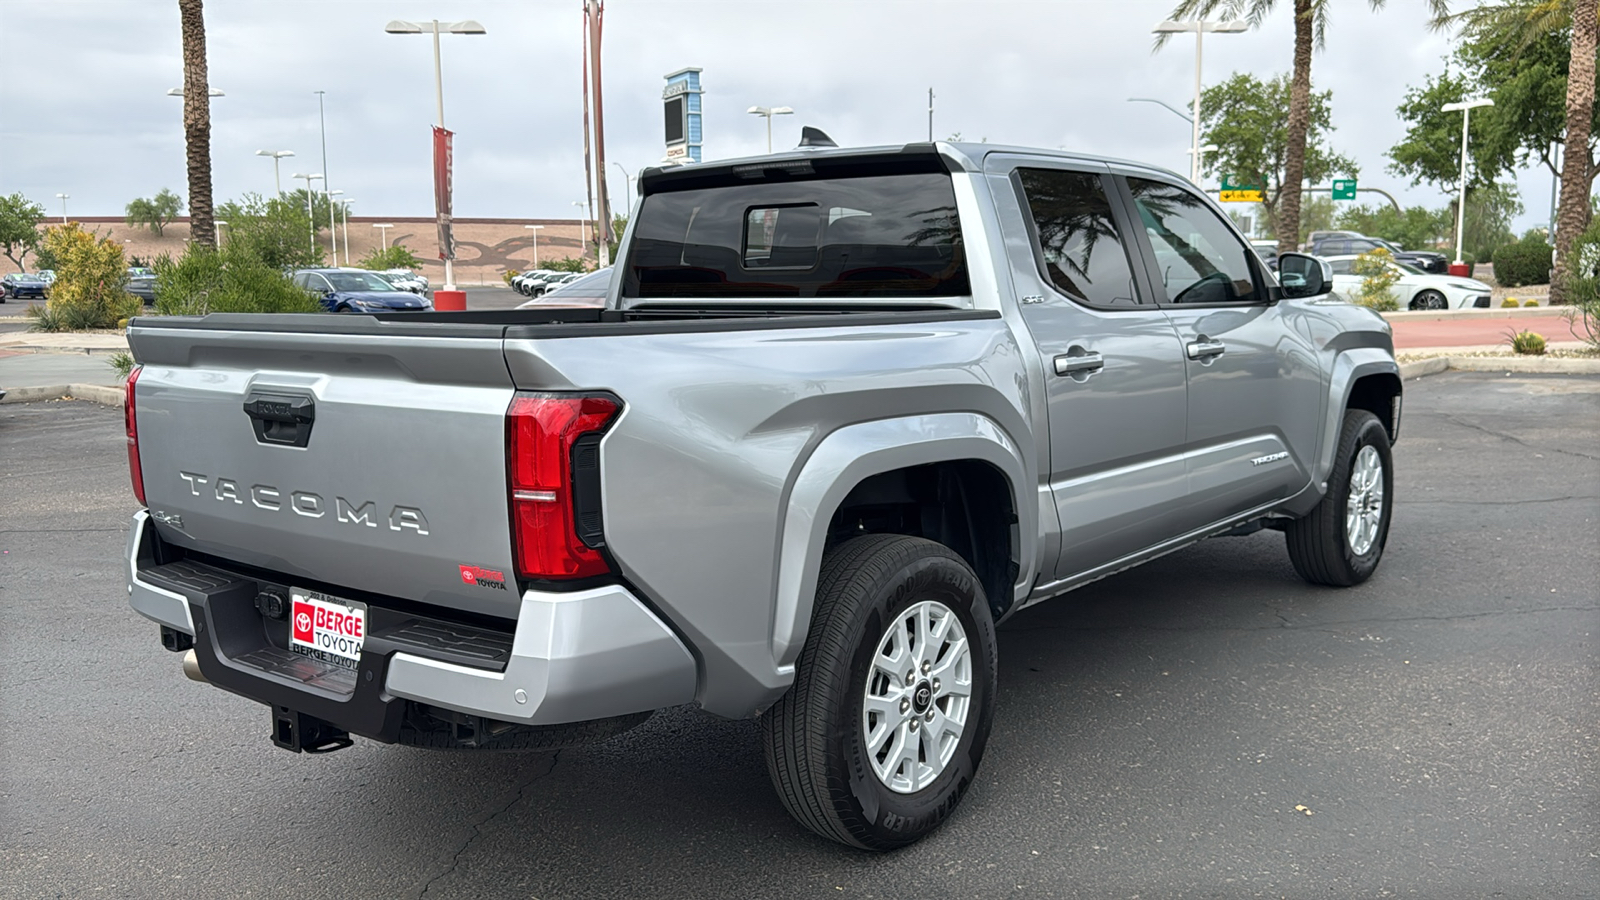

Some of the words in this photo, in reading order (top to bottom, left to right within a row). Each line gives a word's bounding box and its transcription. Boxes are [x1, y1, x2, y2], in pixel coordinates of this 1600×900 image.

[259, 403, 291, 416] TOYOTA
[1250, 451, 1290, 467] TACOMA
[180, 470, 429, 536] TACOMA
[476, 578, 508, 591] TOYOTA
[310, 591, 320, 600] 202
[315, 606, 363, 637] BERGE
[293, 643, 327, 660] BERGE
[315, 631, 362, 656] TOYOTA
